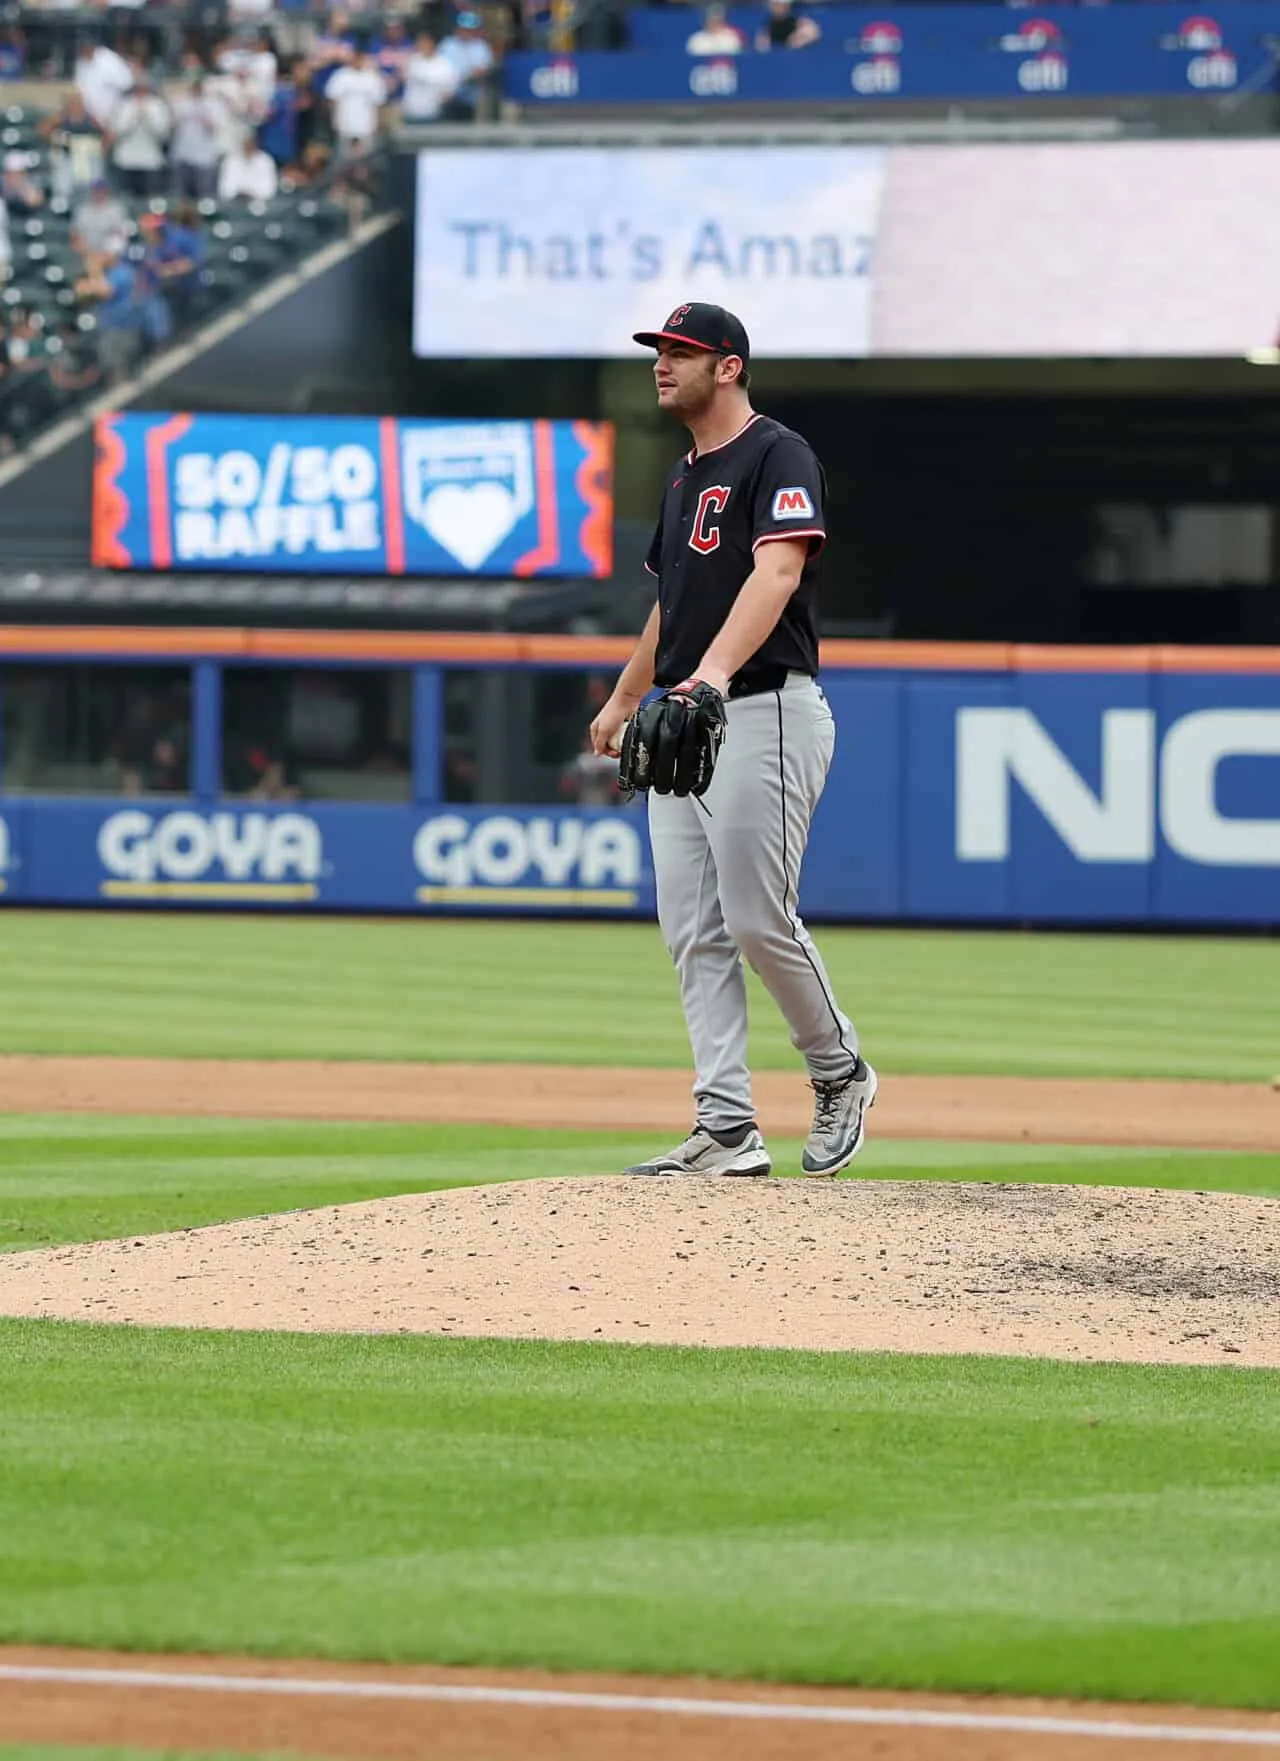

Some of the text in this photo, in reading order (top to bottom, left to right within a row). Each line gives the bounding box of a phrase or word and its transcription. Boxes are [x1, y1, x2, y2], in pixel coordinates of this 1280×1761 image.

[449, 217, 663, 281] That's
[669, 304, 692, 327] C
[175, 442, 378, 510] 50/50
[174, 500, 381, 561] RAFFLE
[687, 484, 732, 556] C
[97, 809, 322, 881] GOYA
[412, 815, 641, 887] GOYA
